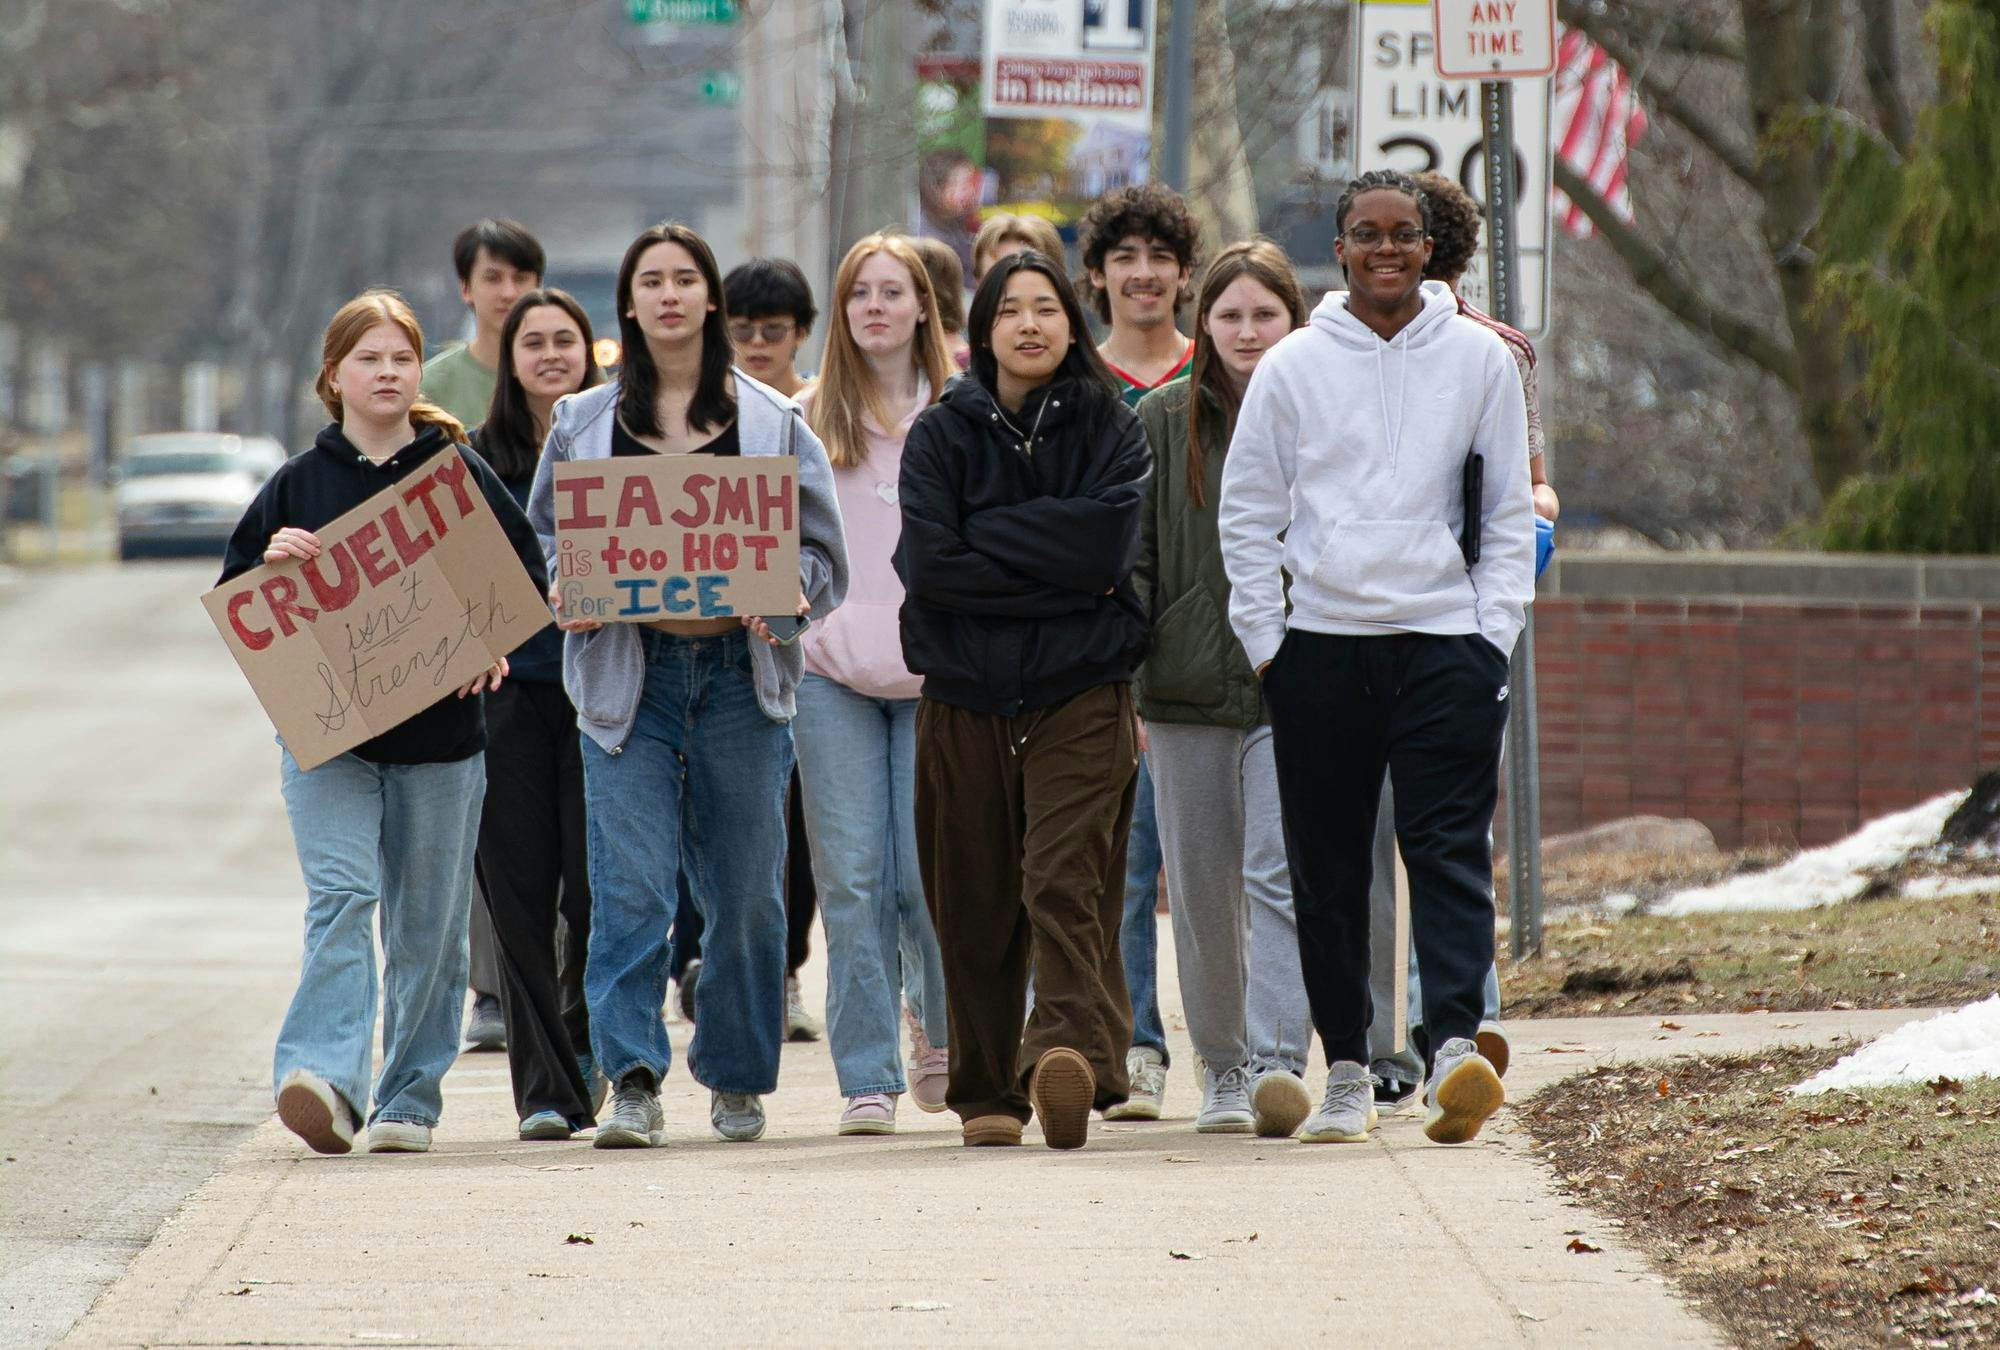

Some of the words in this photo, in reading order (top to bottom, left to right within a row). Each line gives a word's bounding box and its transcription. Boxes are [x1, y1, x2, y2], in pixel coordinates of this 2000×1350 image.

[1471, 1, 1515, 23] ANY
[1467, 31, 1523, 55] TIME
[1001, 78, 1028, 103] in
[1036, 77, 1141, 105] Indiana
[1390, 82, 1468, 117] LIM
[227, 455, 476, 651] CRUELTY
[560, 540, 592, 577] is
[601, 536, 668, 574] too
[682, 532, 779, 572] HOT
[346, 571, 432, 653] isn't
[560, 581, 614, 617] for
[614, 576, 733, 616] ICE
[315, 582, 518, 735] Strength
